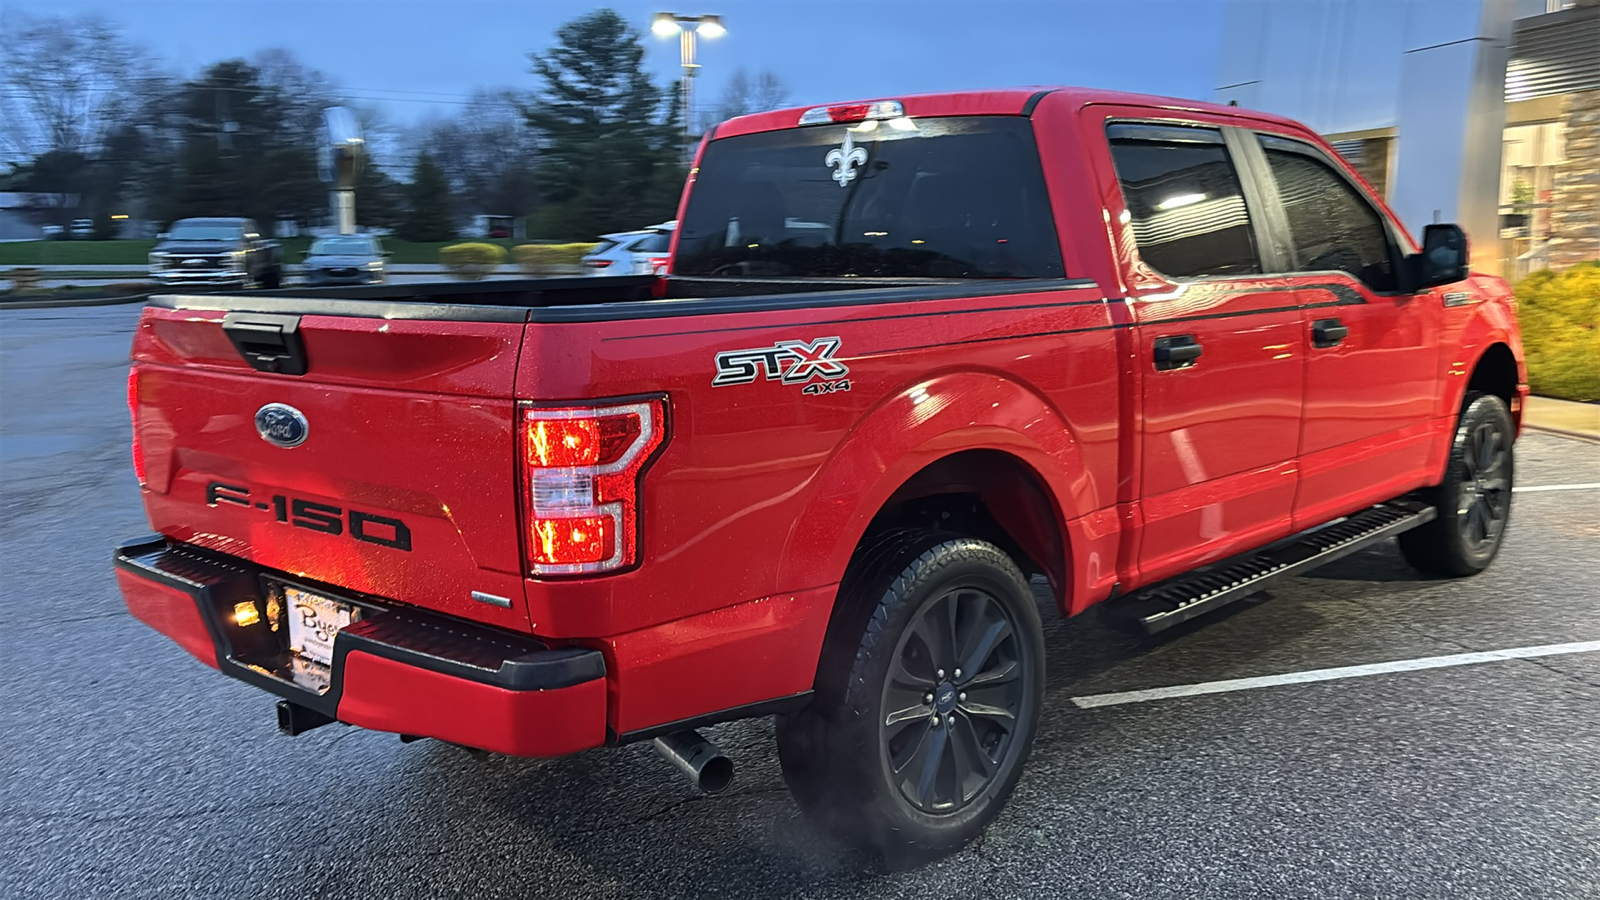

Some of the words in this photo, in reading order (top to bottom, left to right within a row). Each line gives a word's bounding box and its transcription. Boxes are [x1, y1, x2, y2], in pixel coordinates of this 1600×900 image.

[711, 336, 849, 388] STX
[264, 411, 294, 438] Ford
[206, 482, 412, 552] F-150
